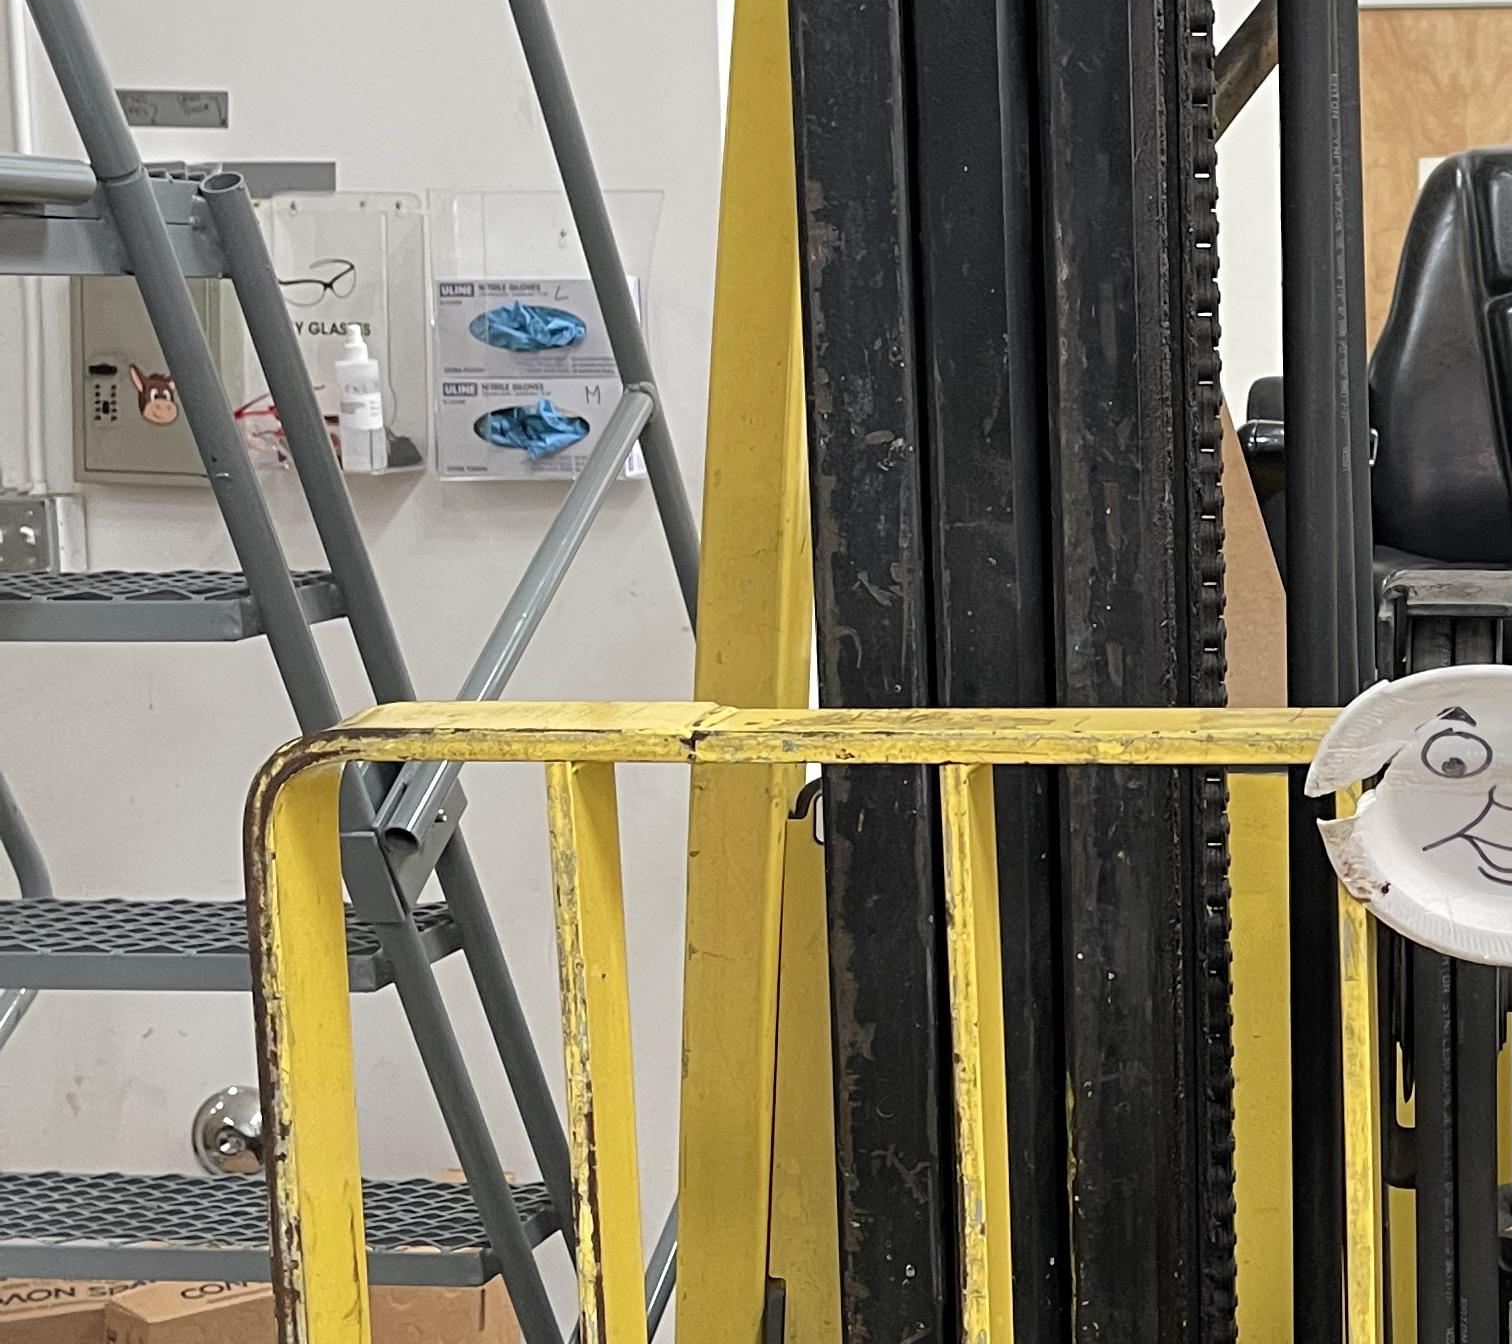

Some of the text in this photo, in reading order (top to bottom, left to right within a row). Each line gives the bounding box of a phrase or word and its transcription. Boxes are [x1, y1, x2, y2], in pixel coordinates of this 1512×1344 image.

[441, 283, 474, 297] ULINE
[308, 321, 371, 336] GLASS
[444, 383, 477, 396] ULINE
[585, 385, 601, 405] M
